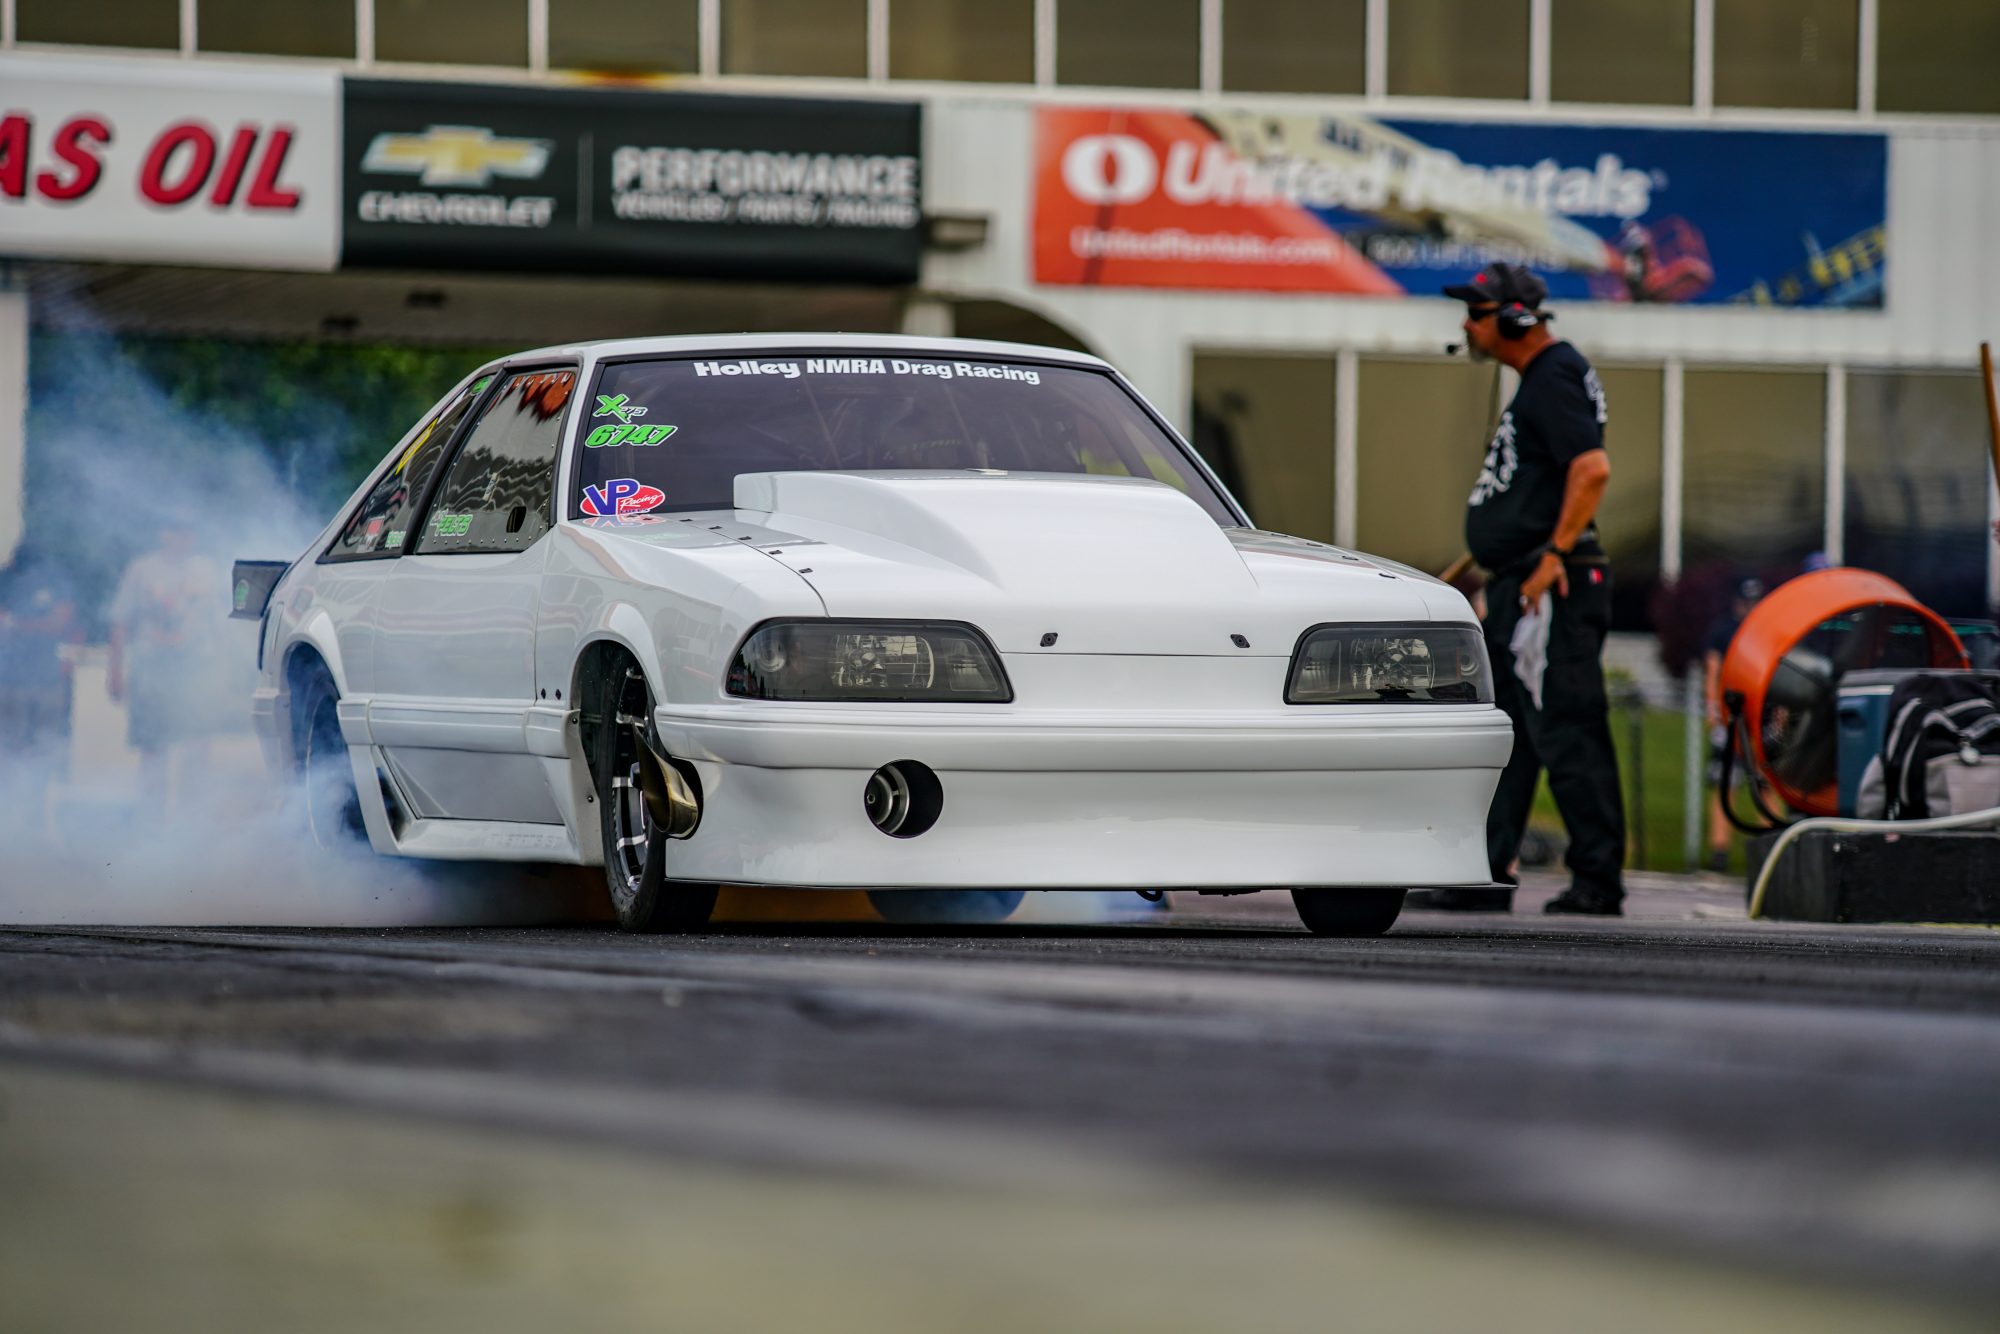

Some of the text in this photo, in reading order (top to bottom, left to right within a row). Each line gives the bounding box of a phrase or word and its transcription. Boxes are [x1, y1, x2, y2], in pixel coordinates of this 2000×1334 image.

[139, 122, 302, 210] OIL
[612, 146, 917, 196] PERFORMANCE
[1163, 138, 1652, 218] United Rentals
[358, 191, 556, 227] CHEVROLET
[693, 359, 1041, 386] Holley NMRA Drag Racing
[585, 424, 678, 448] 6747
[582, 478, 640, 516] VP
[620, 495, 660, 510] Racing
